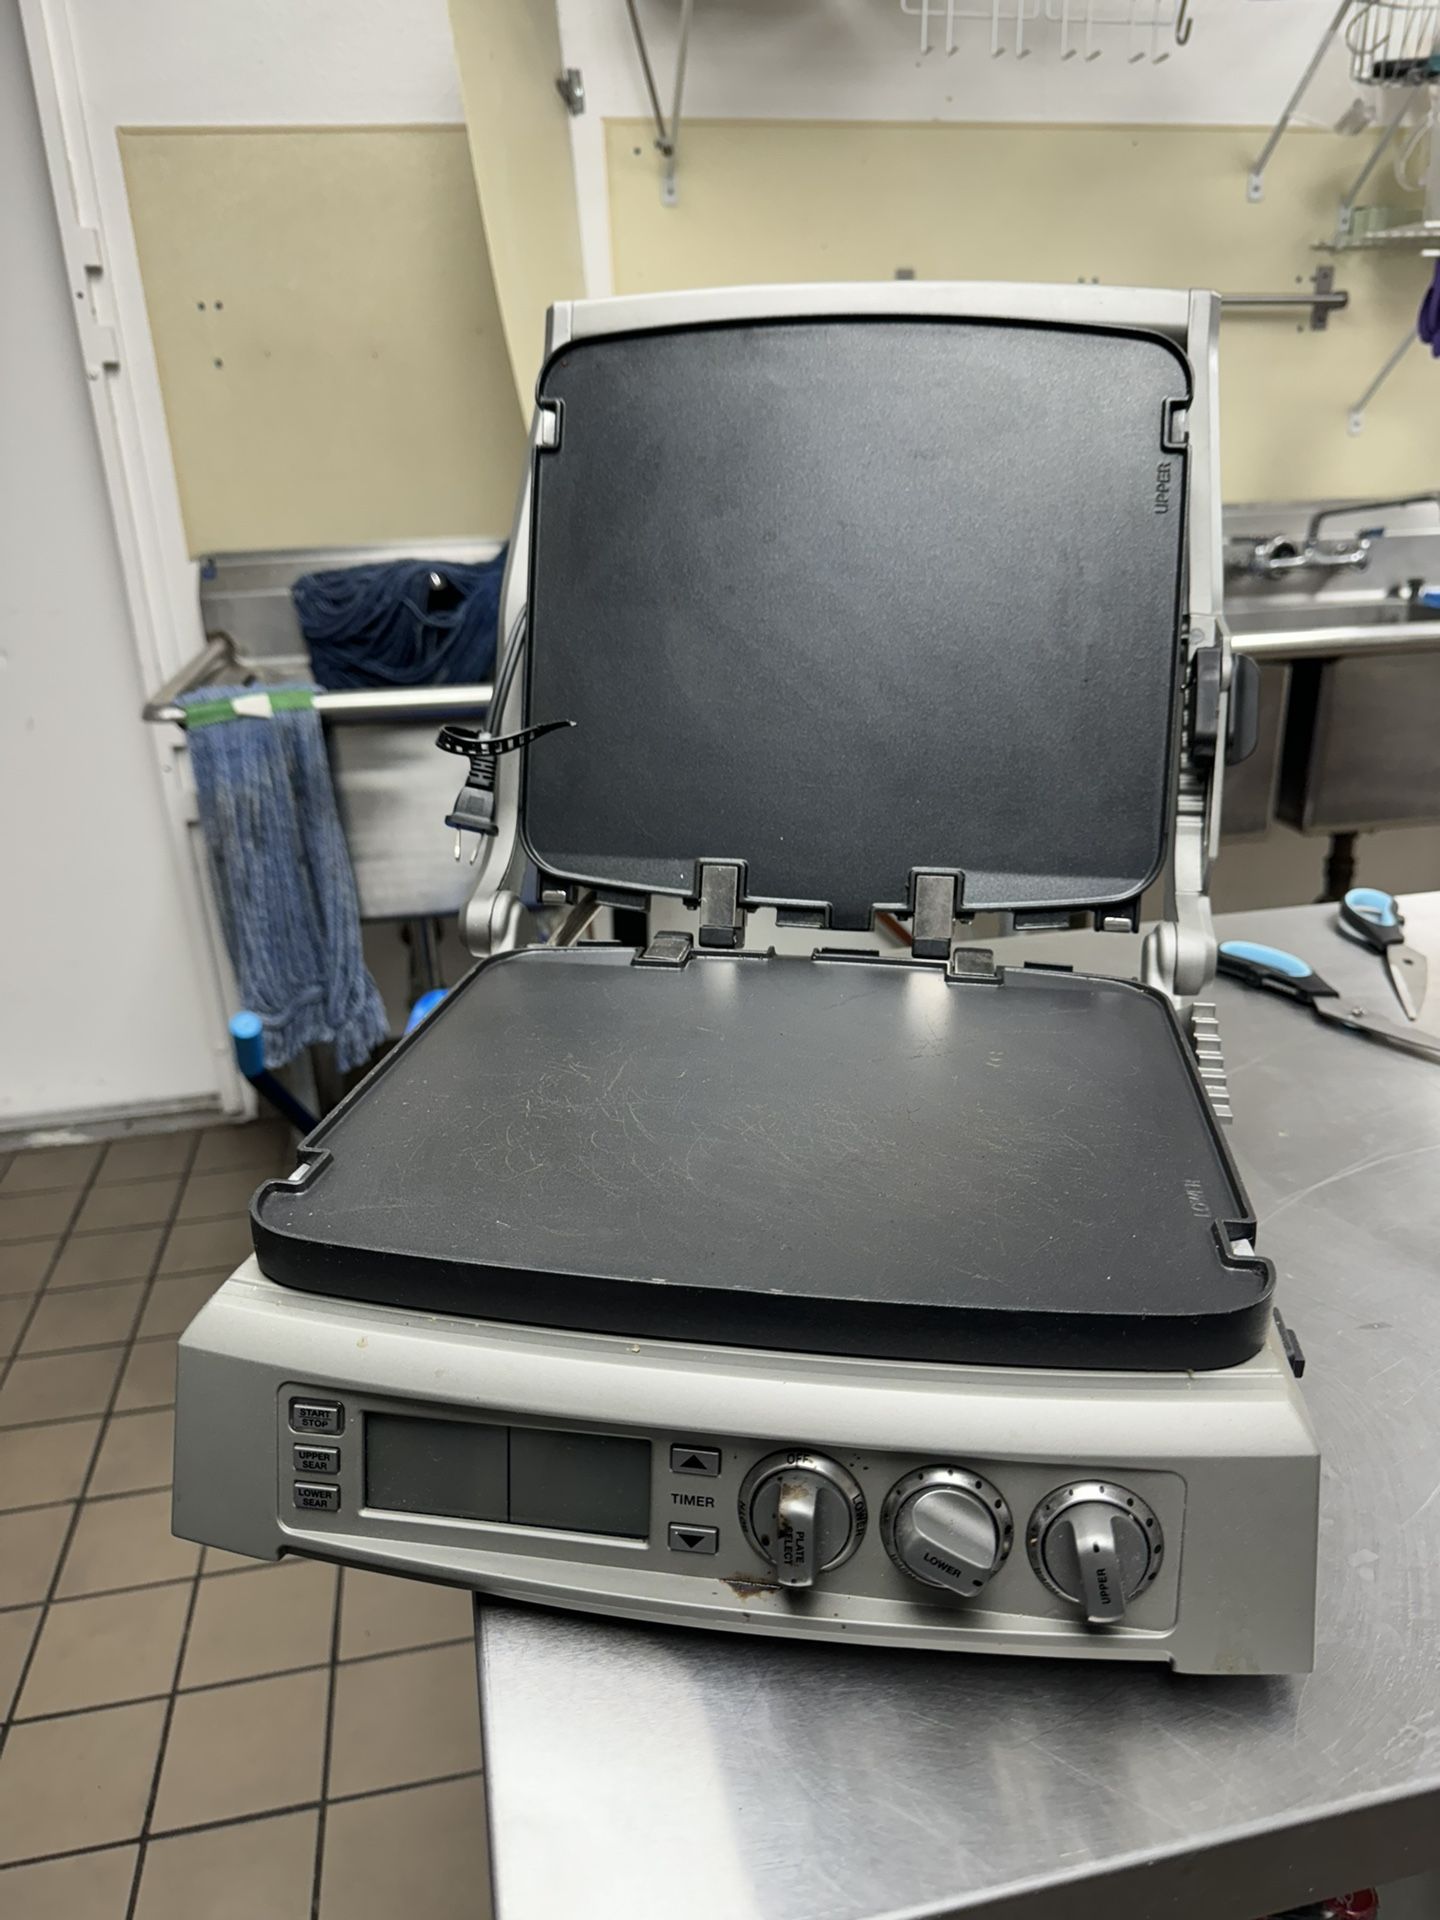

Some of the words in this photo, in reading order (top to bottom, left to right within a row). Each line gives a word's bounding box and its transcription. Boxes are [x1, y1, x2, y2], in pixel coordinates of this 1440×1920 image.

[1155, 462, 1171, 514] UPPER
[299, 1408, 331, 1418] START
[302, 1419, 328, 1428] STOP
[299, 1451, 331, 1461] UPPER
[786, 1453, 813, 1465] OFF
[302, 1461, 327, 1470] SEAR
[298, 1488, 332, 1499] LOWER
[303, 1499, 328, 1508] SEAR
[670, 1493, 715, 1508] TIMER
[795, 1531, 805, 1564] PLATE
[923, 1552, 962, 1578] LOWER
[1096, 1568, 1111, 1605] UPPER
